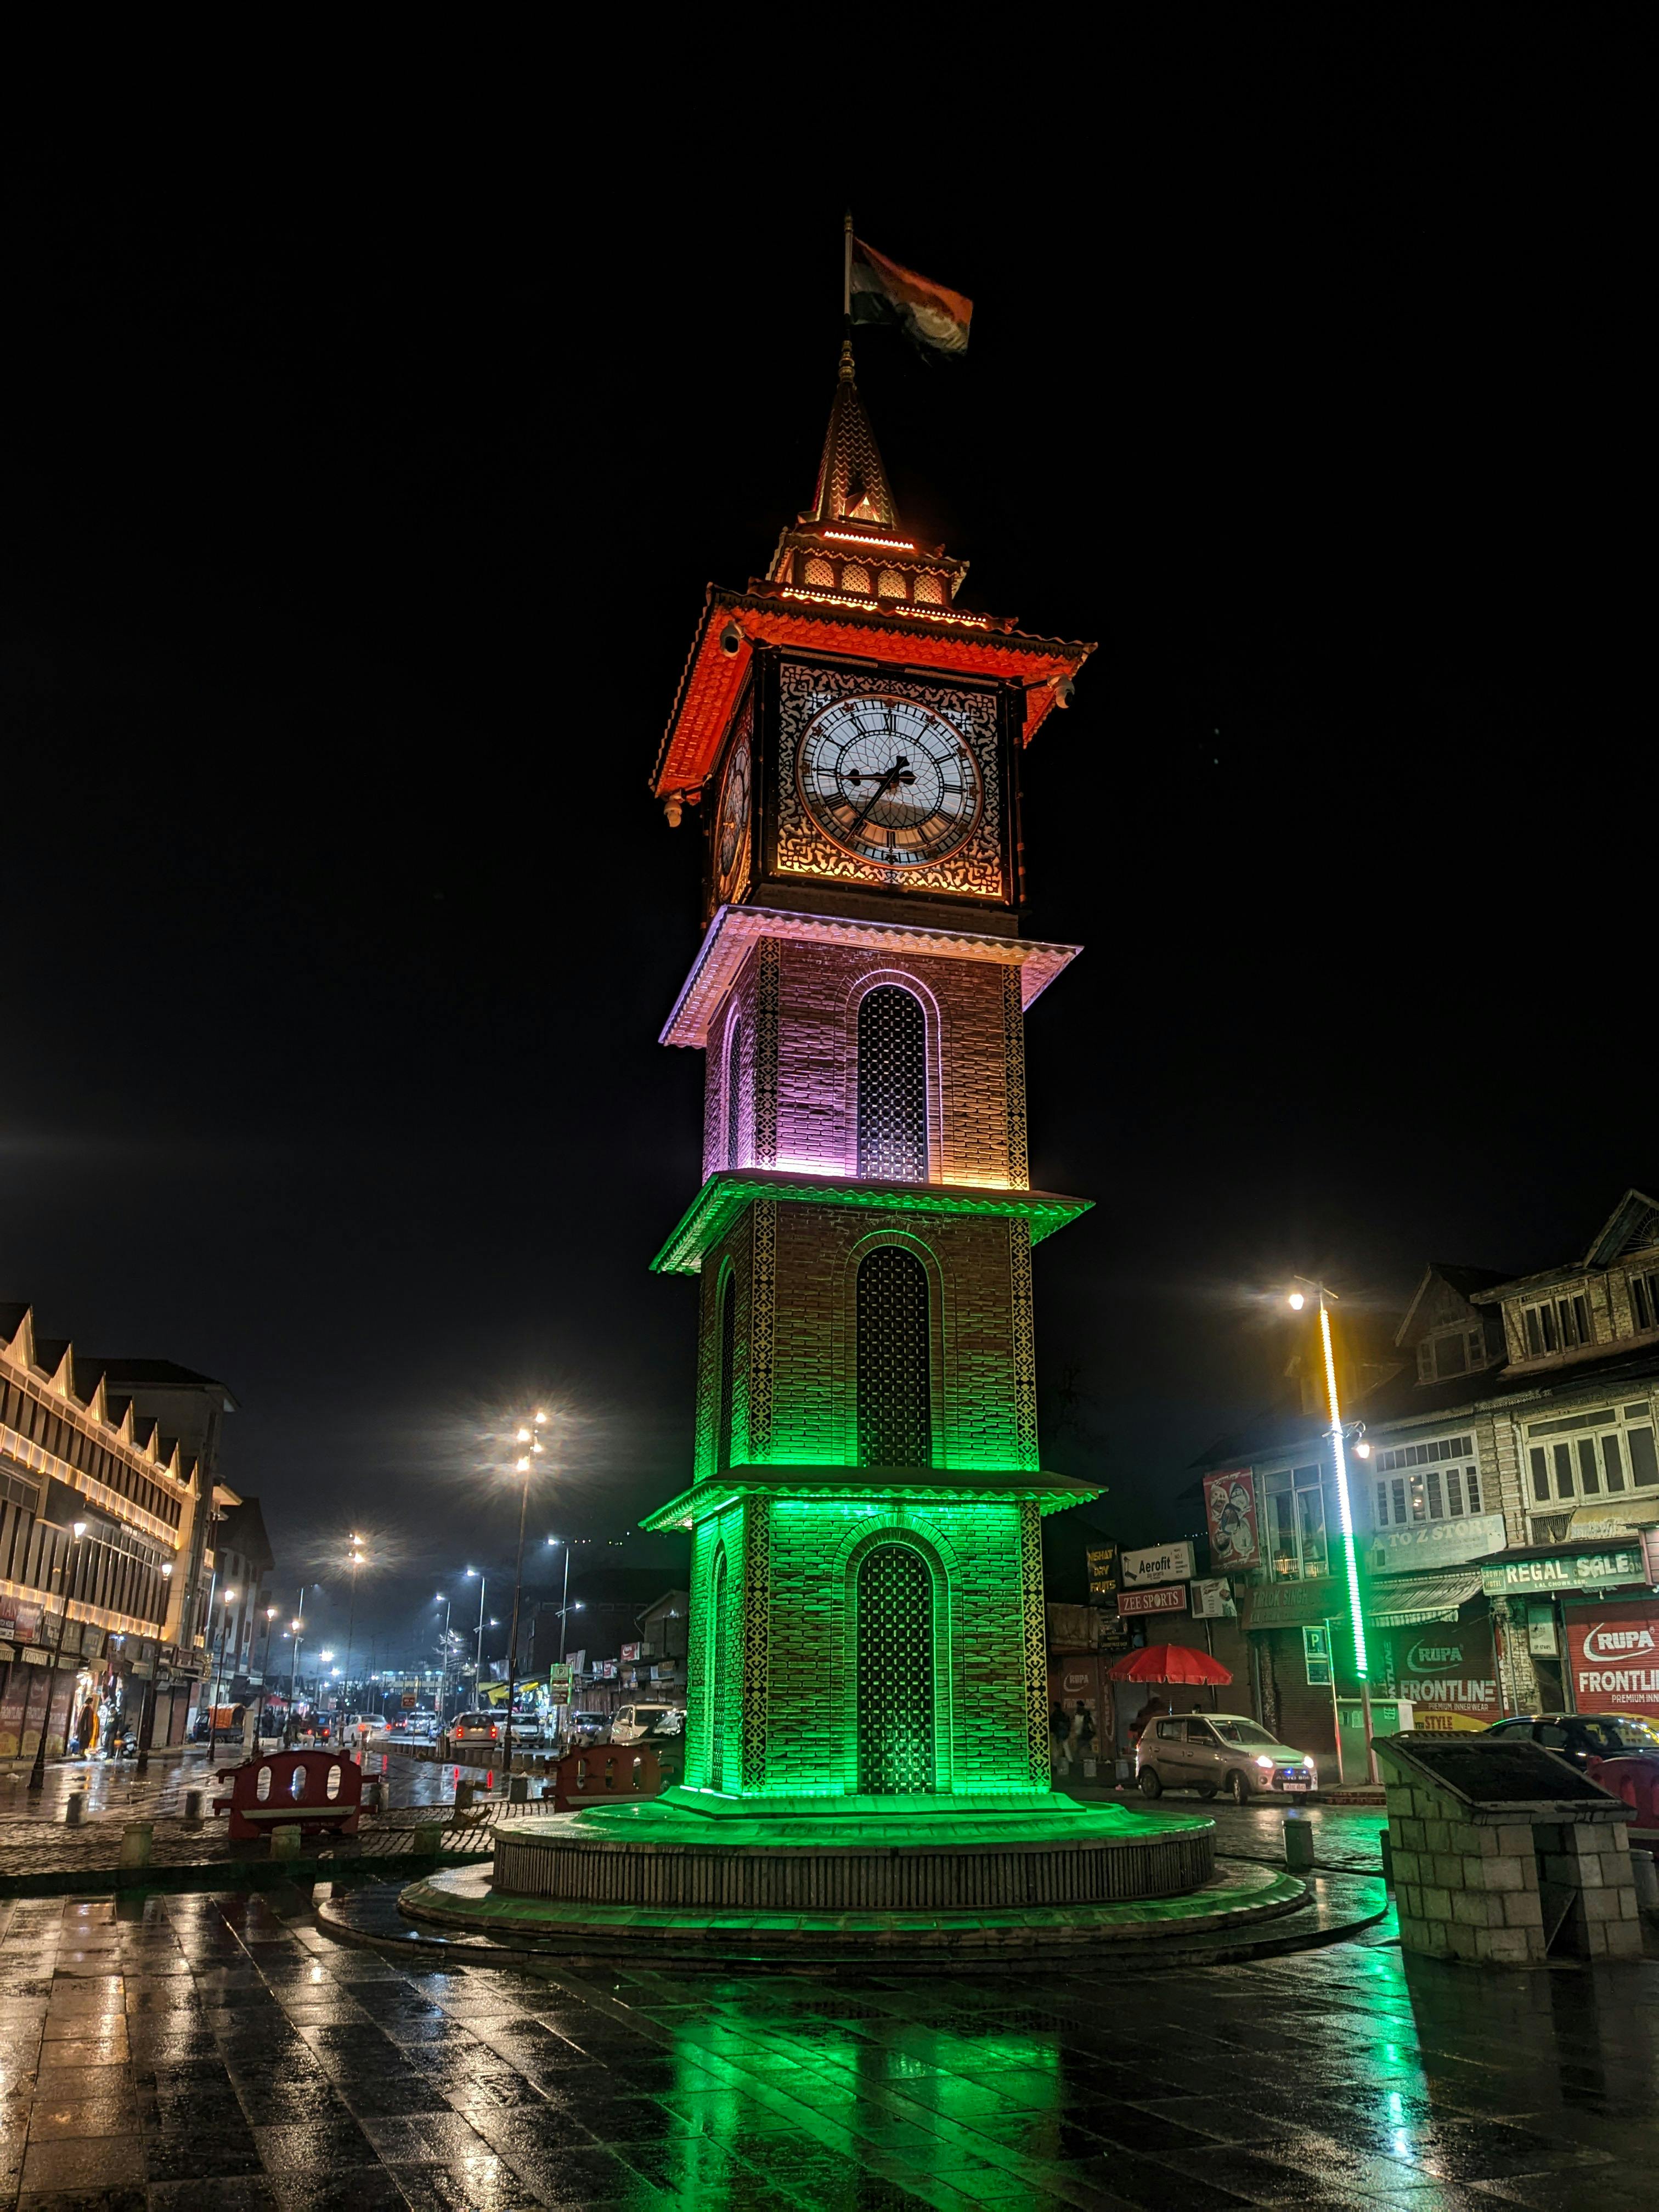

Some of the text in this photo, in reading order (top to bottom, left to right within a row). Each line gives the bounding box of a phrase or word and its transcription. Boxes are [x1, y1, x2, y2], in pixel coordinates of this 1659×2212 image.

[1372, 1537, 1384, 1550] A
[1388, 1532, 1412, 1547] TO
[1417, 1529, 1428, 1543] Z
[1432, 1519, 1496, 1541] STORE
[1093, 1565, 1110, 1577] DRY
[1139, 1556, 1171, 1574] Aerofit
[1505, 1559, 1568, 1583] REGAL
[1576, 1553, 1629, 1578] SALE
[1482, 1570, 1503, 1578] CROWN
[1090, 1579, 1116, 1593] FRUITS
[1485, 1579, 1502, 1588] HOTEL
[1124, 1591, 1179, 1611] ZEE SPORTS
[1311, 1633, 1319, 1647] P
[1598, 1630, 1655, 1650] RUPA
[1418, 1647, 1463, 1662] RUPA
[1400, 1680, 1497, 1702] FRONTLINE
[1611, 1694, 1645, 1703] PREMIUM
[1429, 1703, 1452, 1711] PREMIUM
[1425, 1716, 1453, 1730] STYLE
